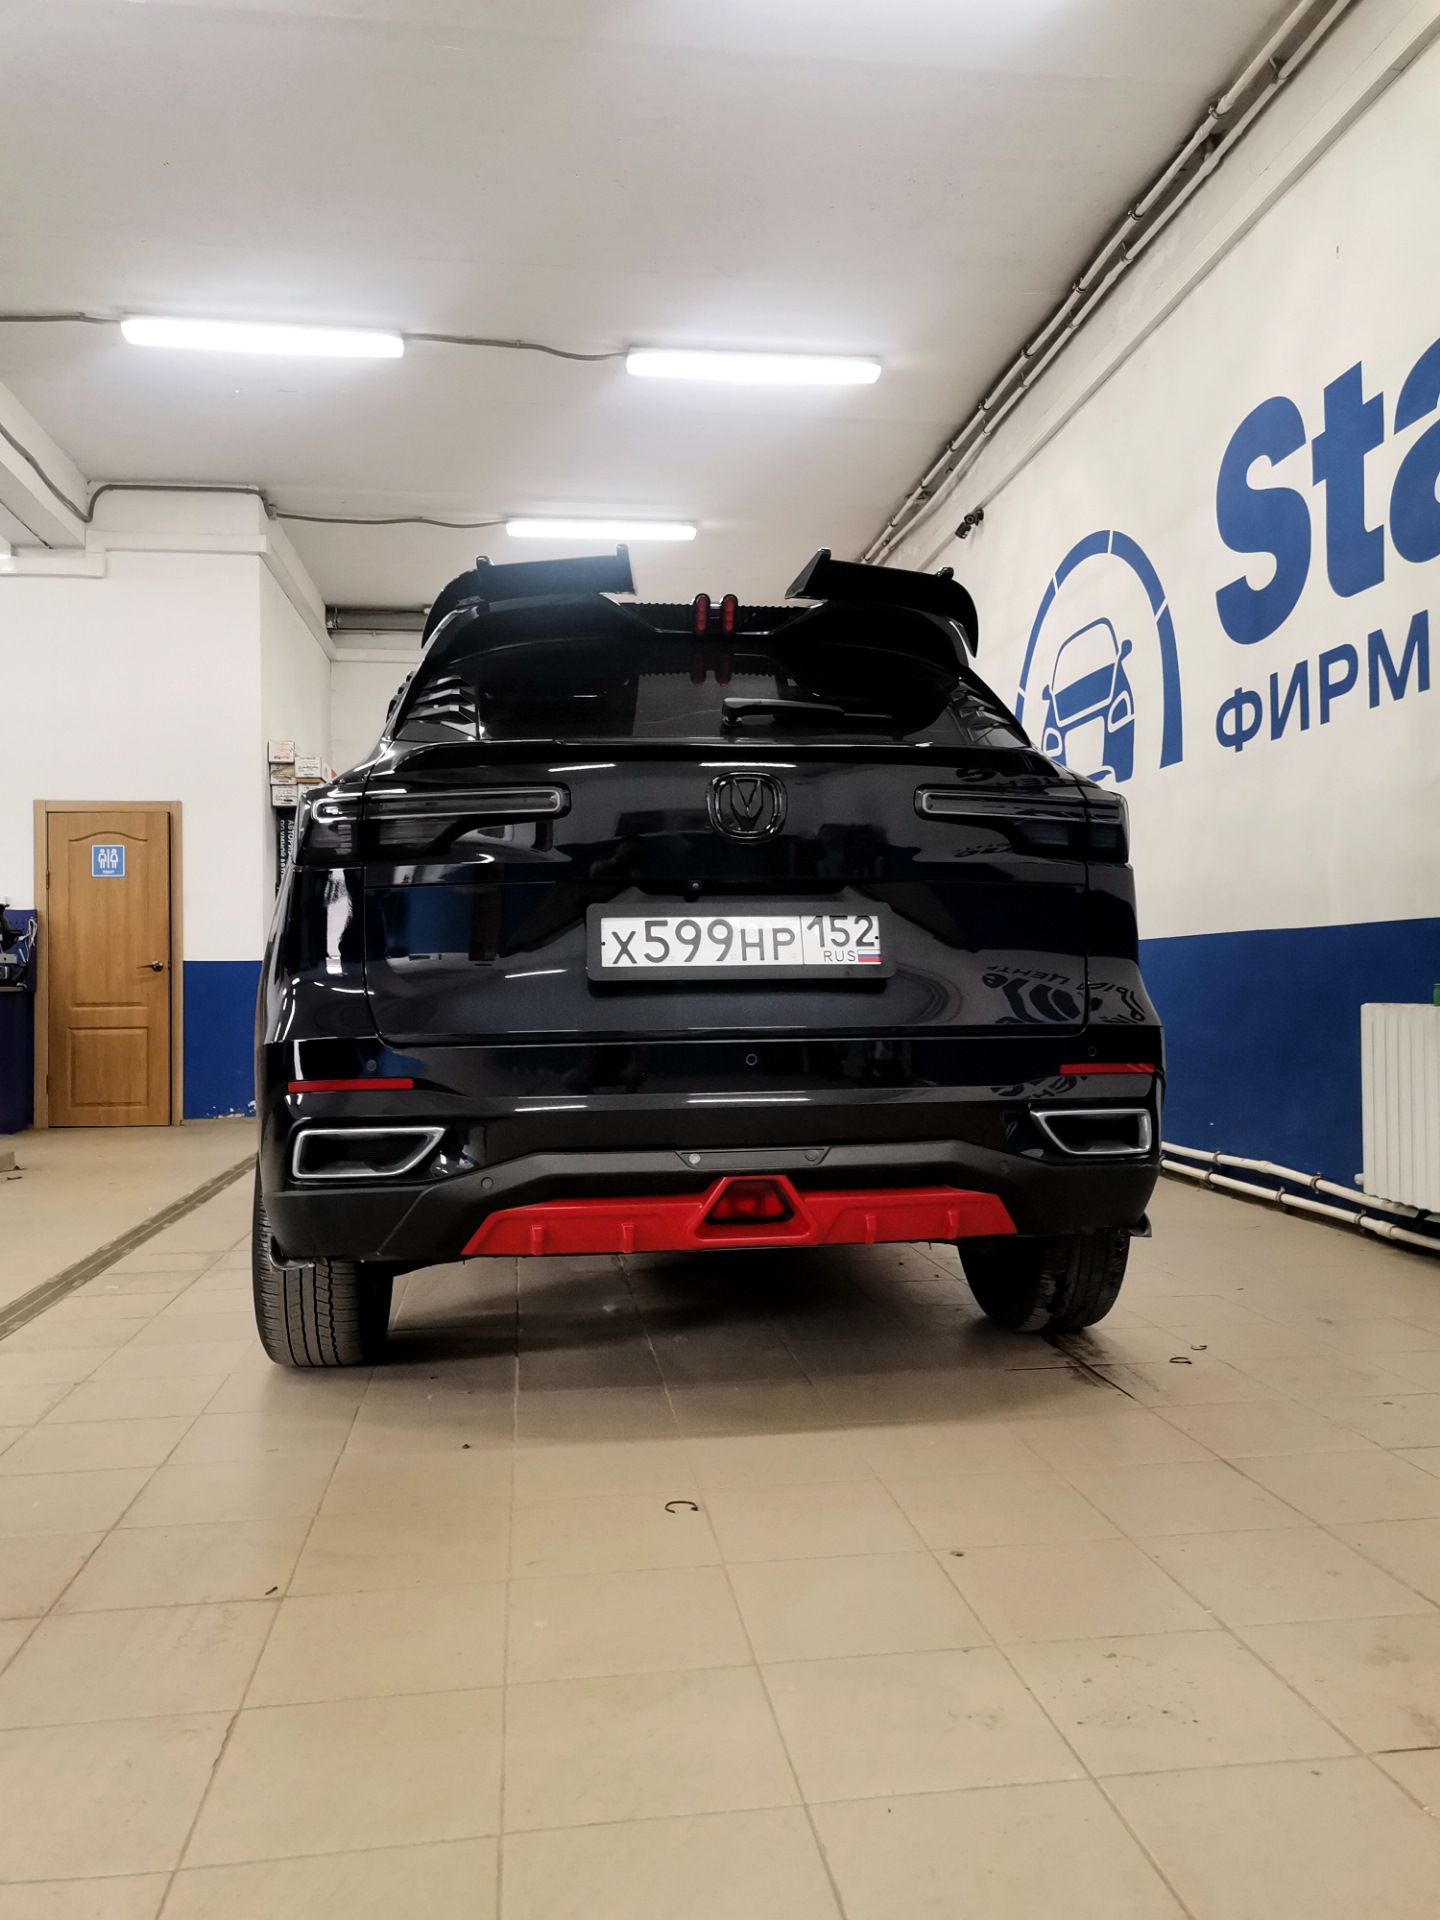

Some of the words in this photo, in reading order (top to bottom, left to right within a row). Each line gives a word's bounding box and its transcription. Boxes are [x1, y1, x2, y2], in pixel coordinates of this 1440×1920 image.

[1216, 609, 1430, 752] ФИРМ
[806, 915, 875, 948] 152
[823, 950, 856, 962] RUS
